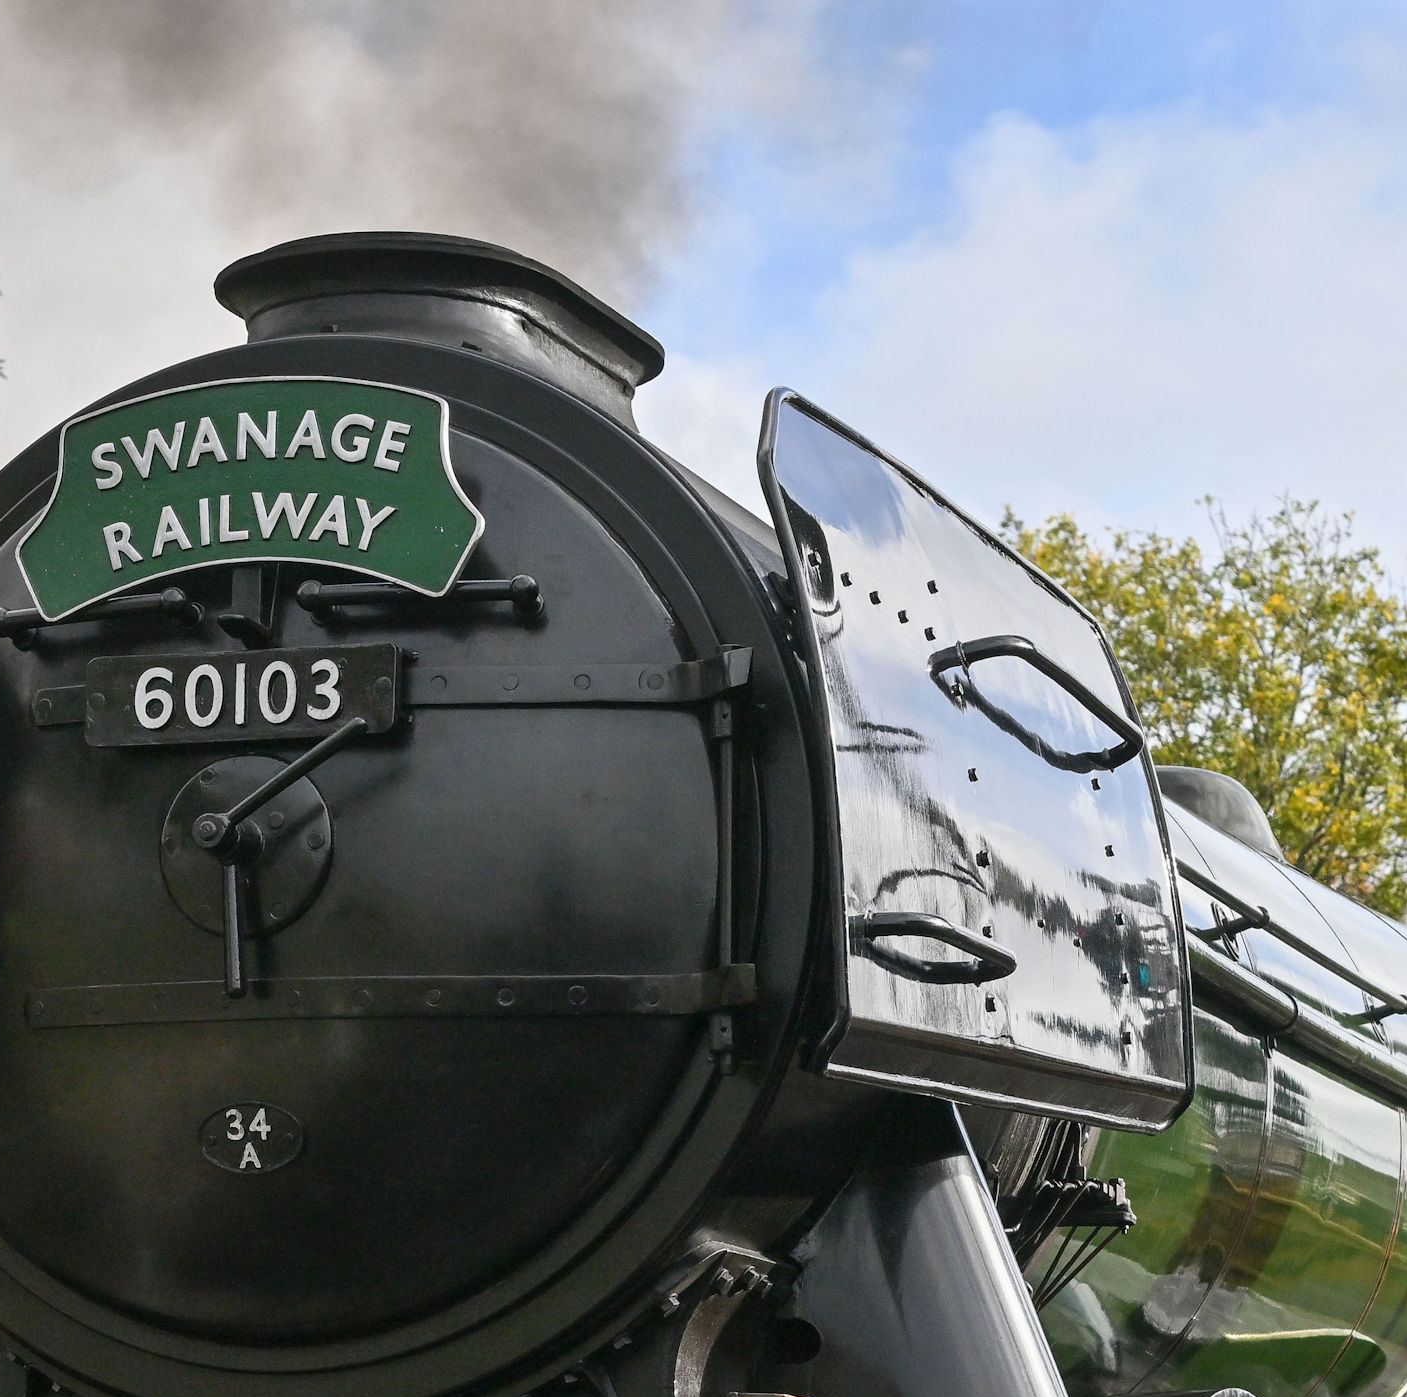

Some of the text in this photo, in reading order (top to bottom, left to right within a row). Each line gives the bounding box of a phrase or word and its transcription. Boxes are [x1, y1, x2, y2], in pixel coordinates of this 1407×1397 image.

[91, 409, 412, 491] SWANAGE
[102, 491, 396, 571] RAILWAY
[133, 658, 342, 730] 60103
[225, 1107, 272, 1141] 34
[239, 1141, 262, 1169] A
